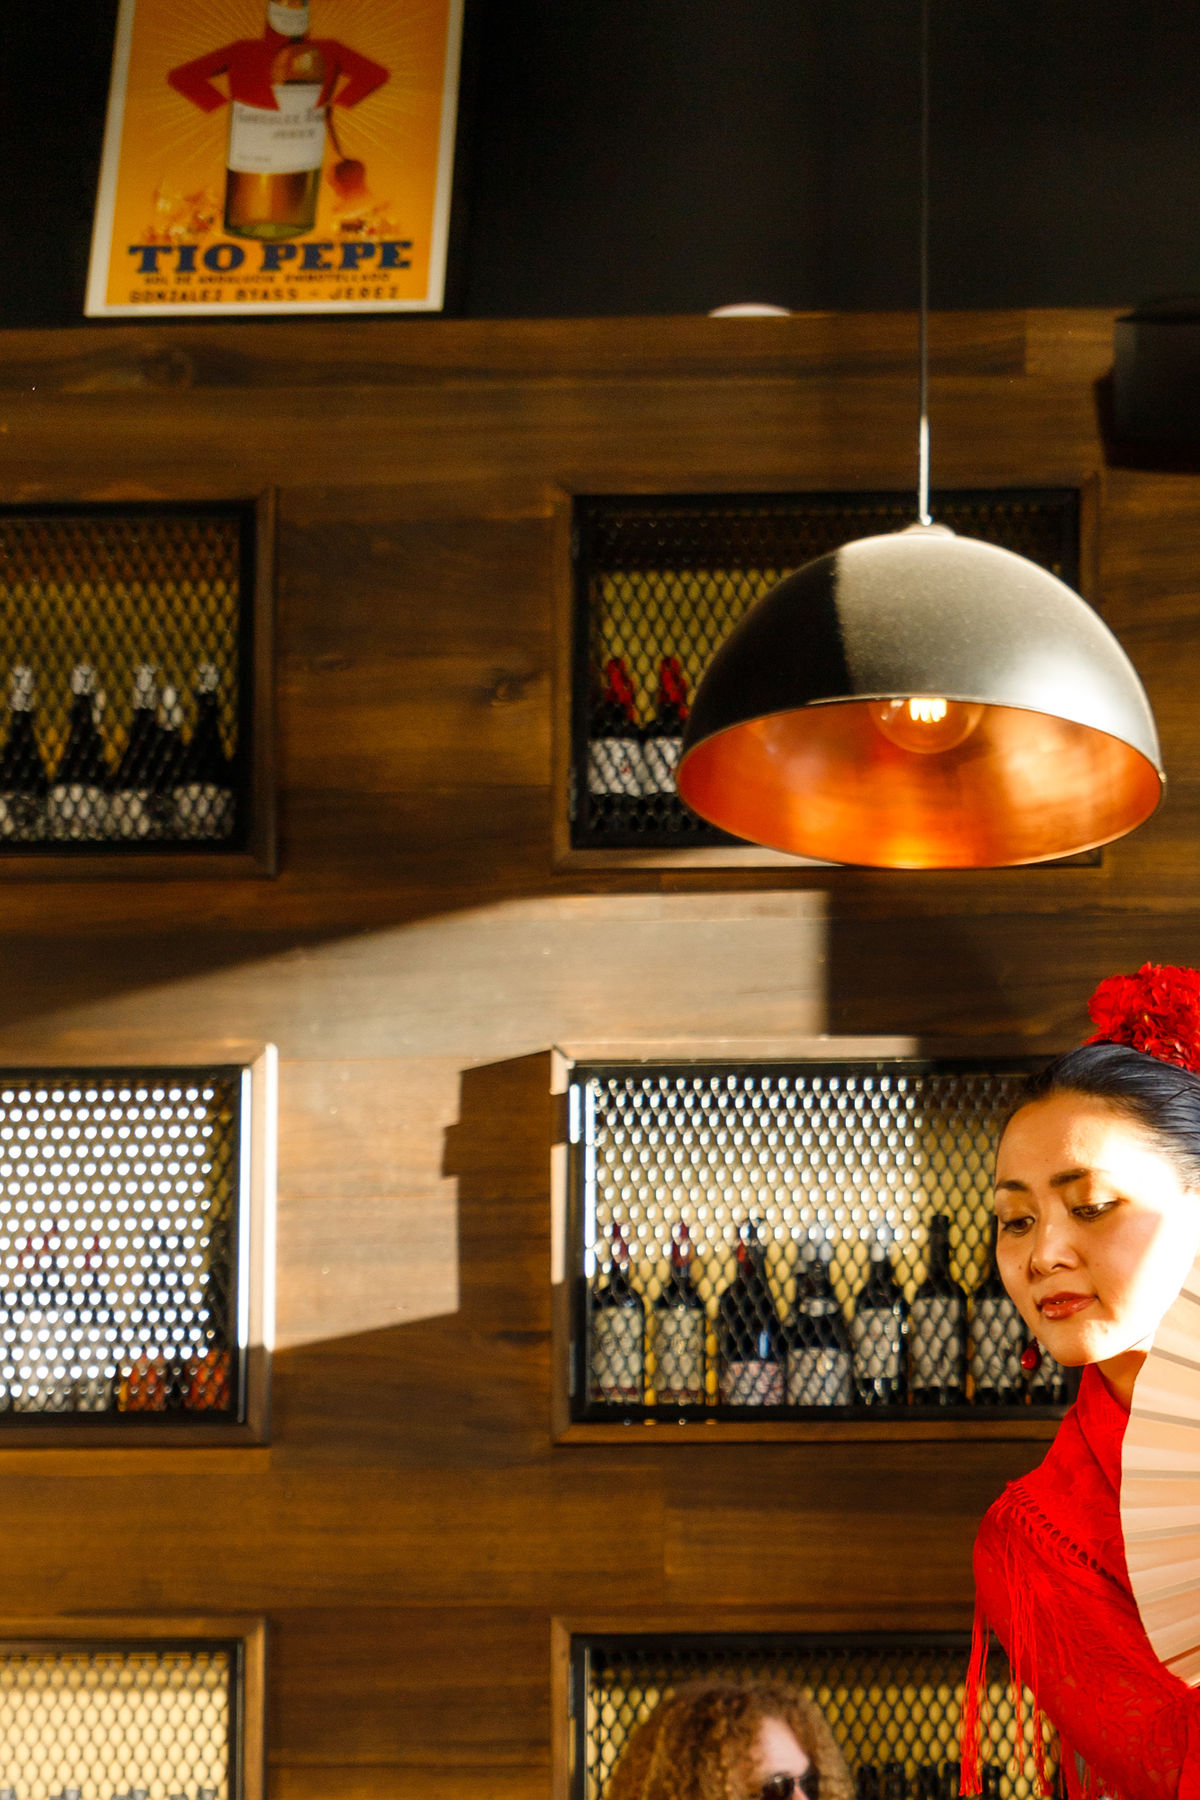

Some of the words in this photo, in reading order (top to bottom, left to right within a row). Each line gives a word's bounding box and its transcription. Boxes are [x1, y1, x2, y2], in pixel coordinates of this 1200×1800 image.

[128, 244, 245, 272] TIO
[260, 242, 411, 270] PEPE
[175, 275, 191, 284] DE
[130, 288, 222, 303] GONZALEZ
[236, 287, 298, 302] BYASS
[329, 286, 398, 301] JEREZ
